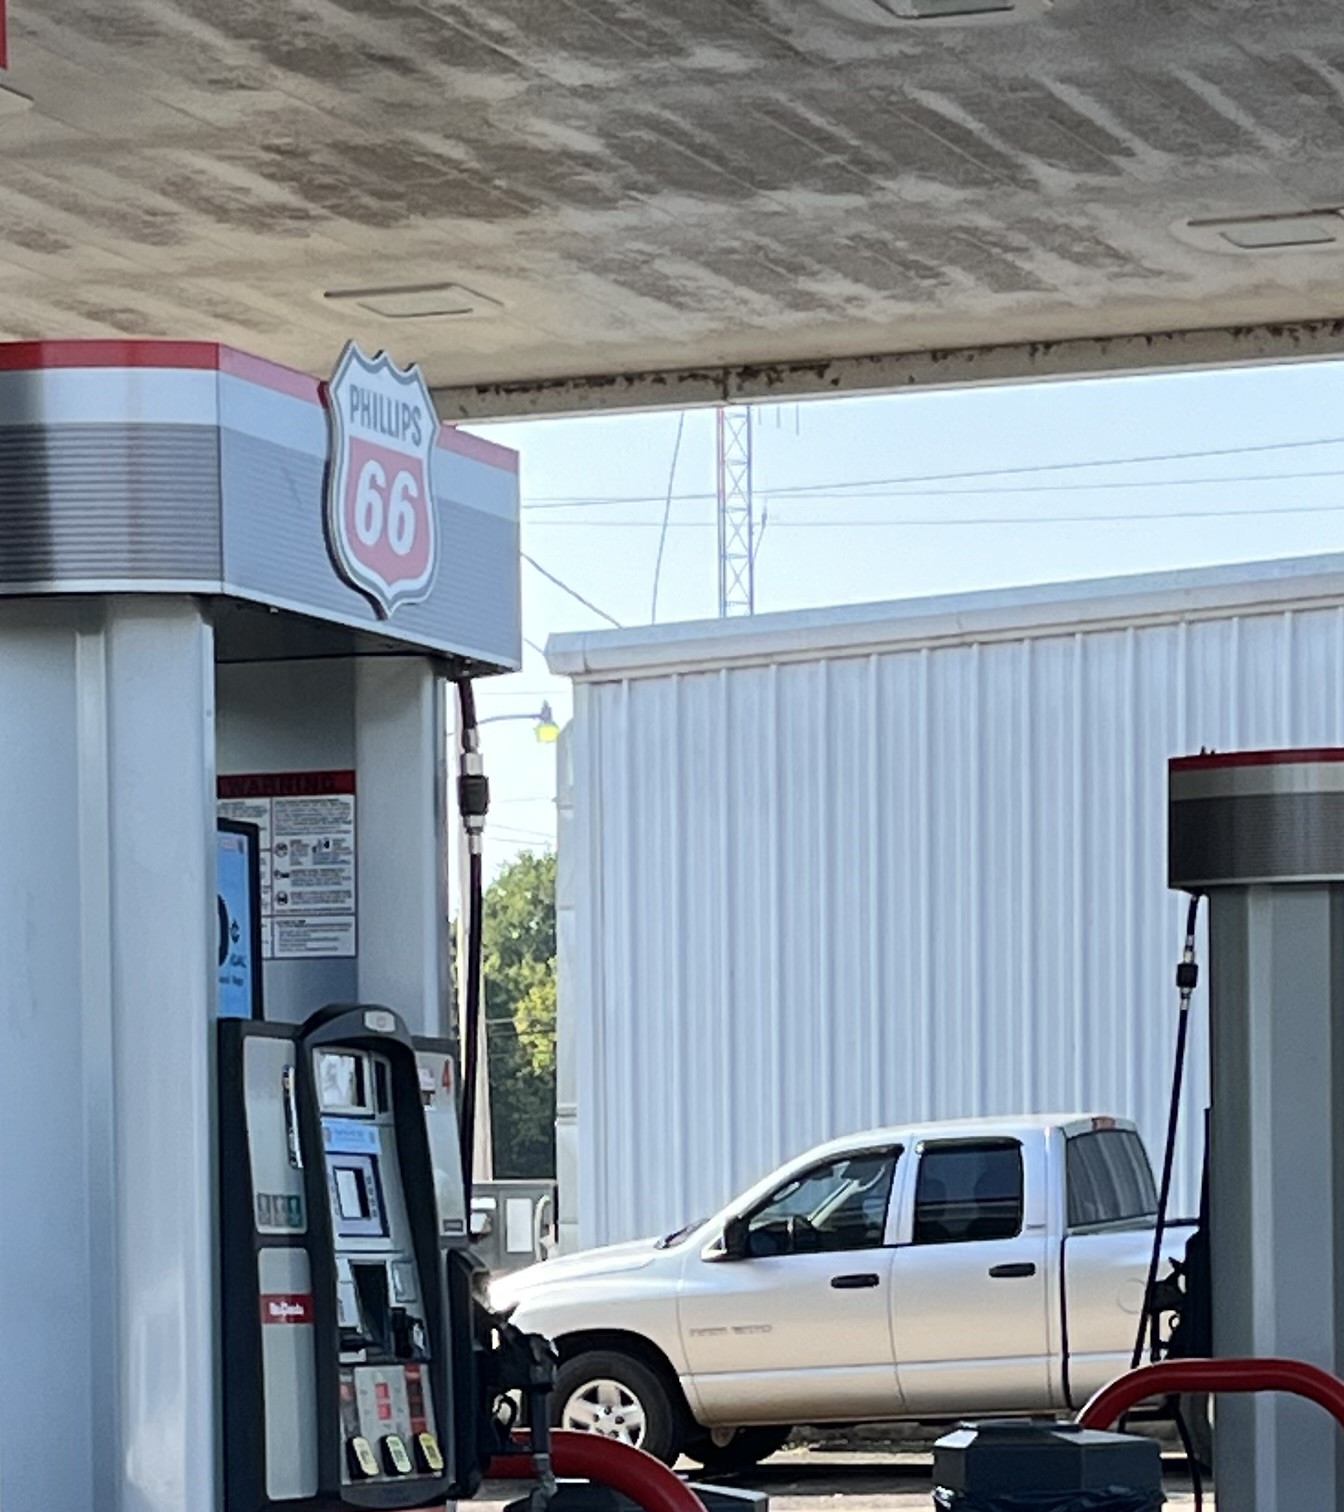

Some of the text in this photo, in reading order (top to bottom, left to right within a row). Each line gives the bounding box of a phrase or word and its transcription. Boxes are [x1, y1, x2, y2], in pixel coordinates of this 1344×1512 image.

[349, 384, 422, 447] PHILLIPS
[355, 459, 419, 556] 66
[441, 1058, 451, 1095] 4
